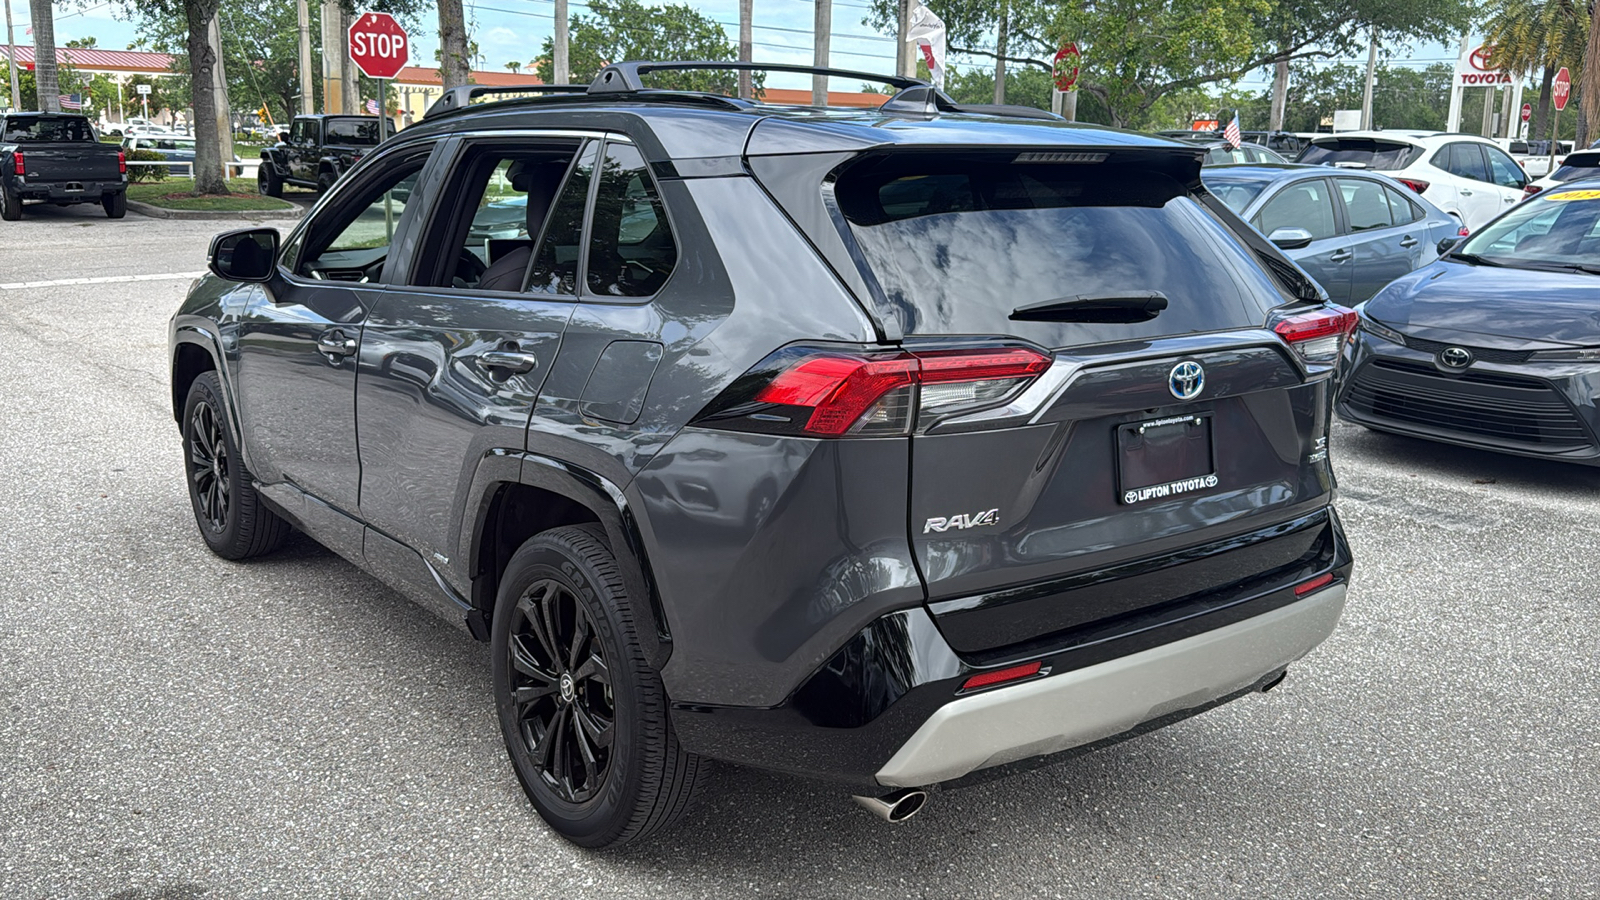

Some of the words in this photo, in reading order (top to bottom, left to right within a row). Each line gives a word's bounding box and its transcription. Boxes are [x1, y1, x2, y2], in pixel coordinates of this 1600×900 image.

[354, 32, 404, 58] STOP
[1461, 73, 1512, 84] TOYOTA
[1554, 81, 1570, 97] STOP
[1143, 416, 1193, 427] www.liptontoyota.com
[1138, 486, 1169, 500] LIPTON
[1171, 478, 1206, 493] TOYOTA
[923, 508, 999, 534] RAV4
